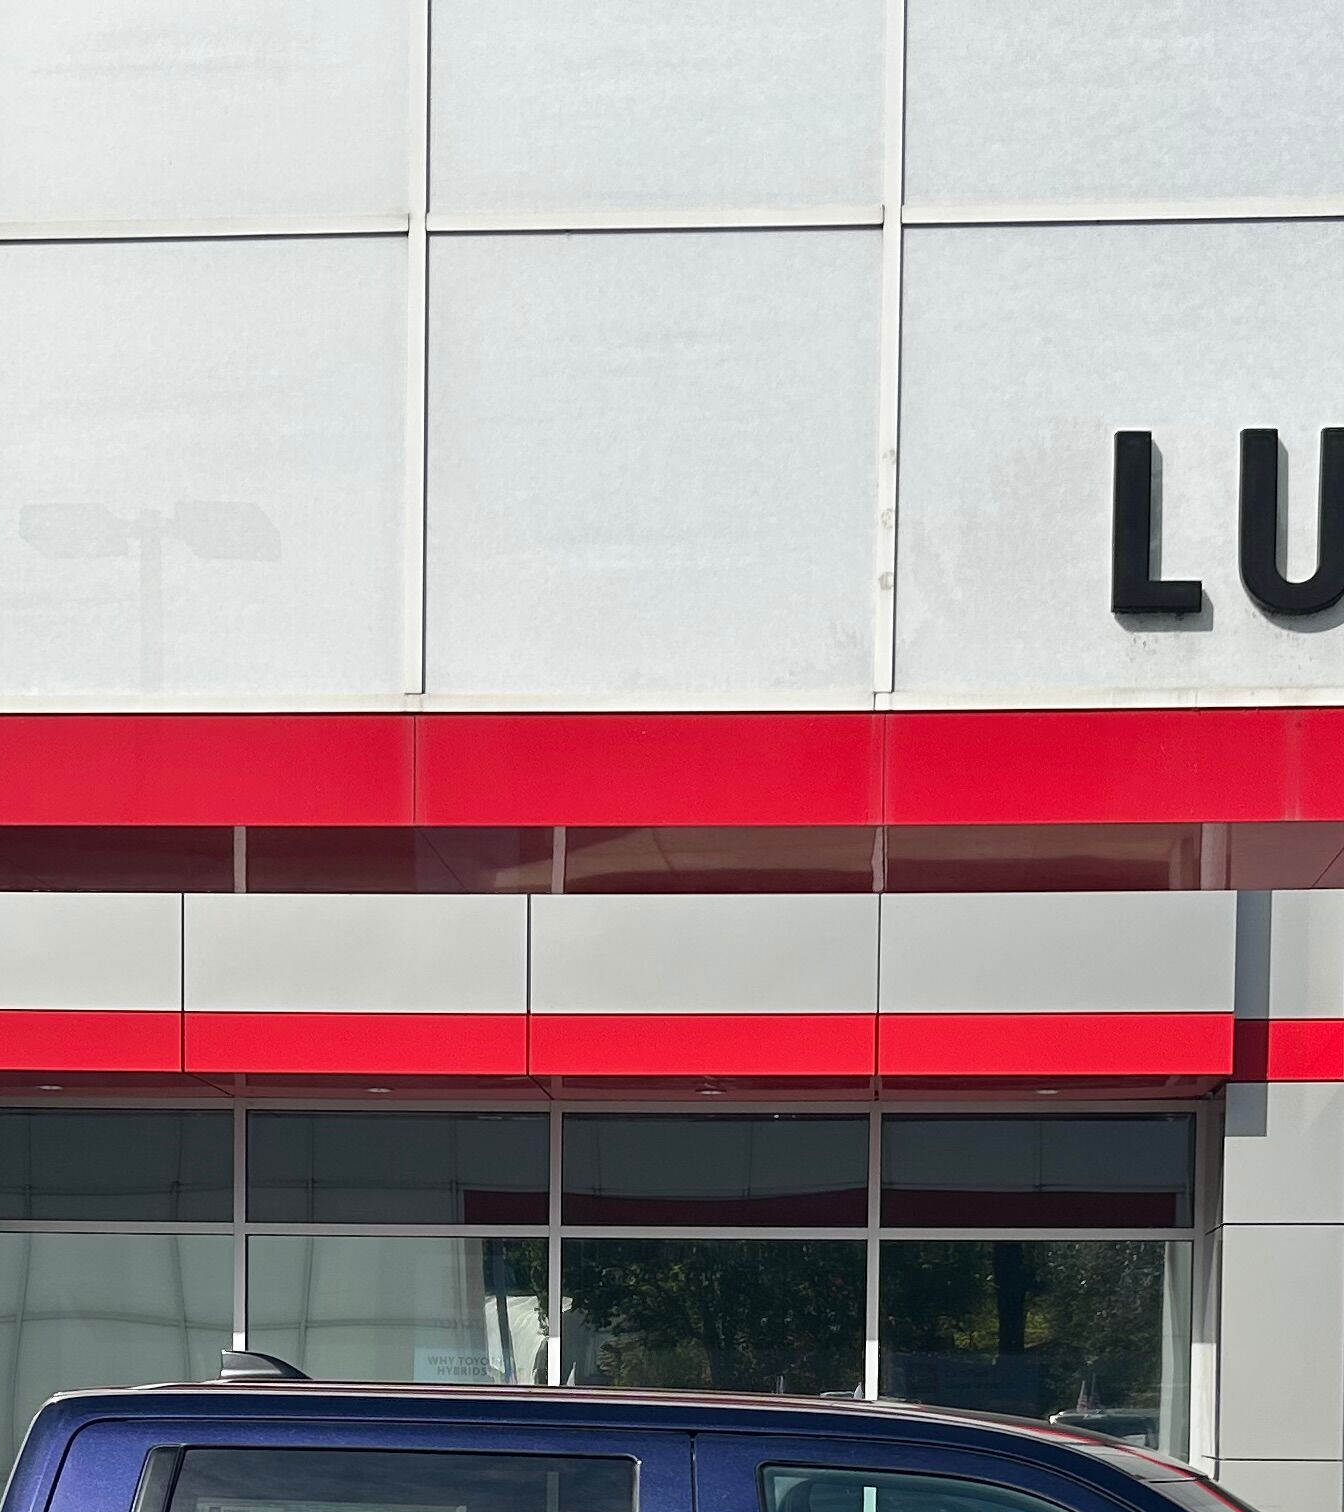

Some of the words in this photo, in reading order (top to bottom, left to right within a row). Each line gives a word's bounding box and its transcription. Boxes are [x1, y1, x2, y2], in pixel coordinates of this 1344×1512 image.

[428, 1356, 455, 1366] WHY
[458, 1356, 491, 1366] TOYO
[437, 1366, 487, 1377] HYBRIDS
